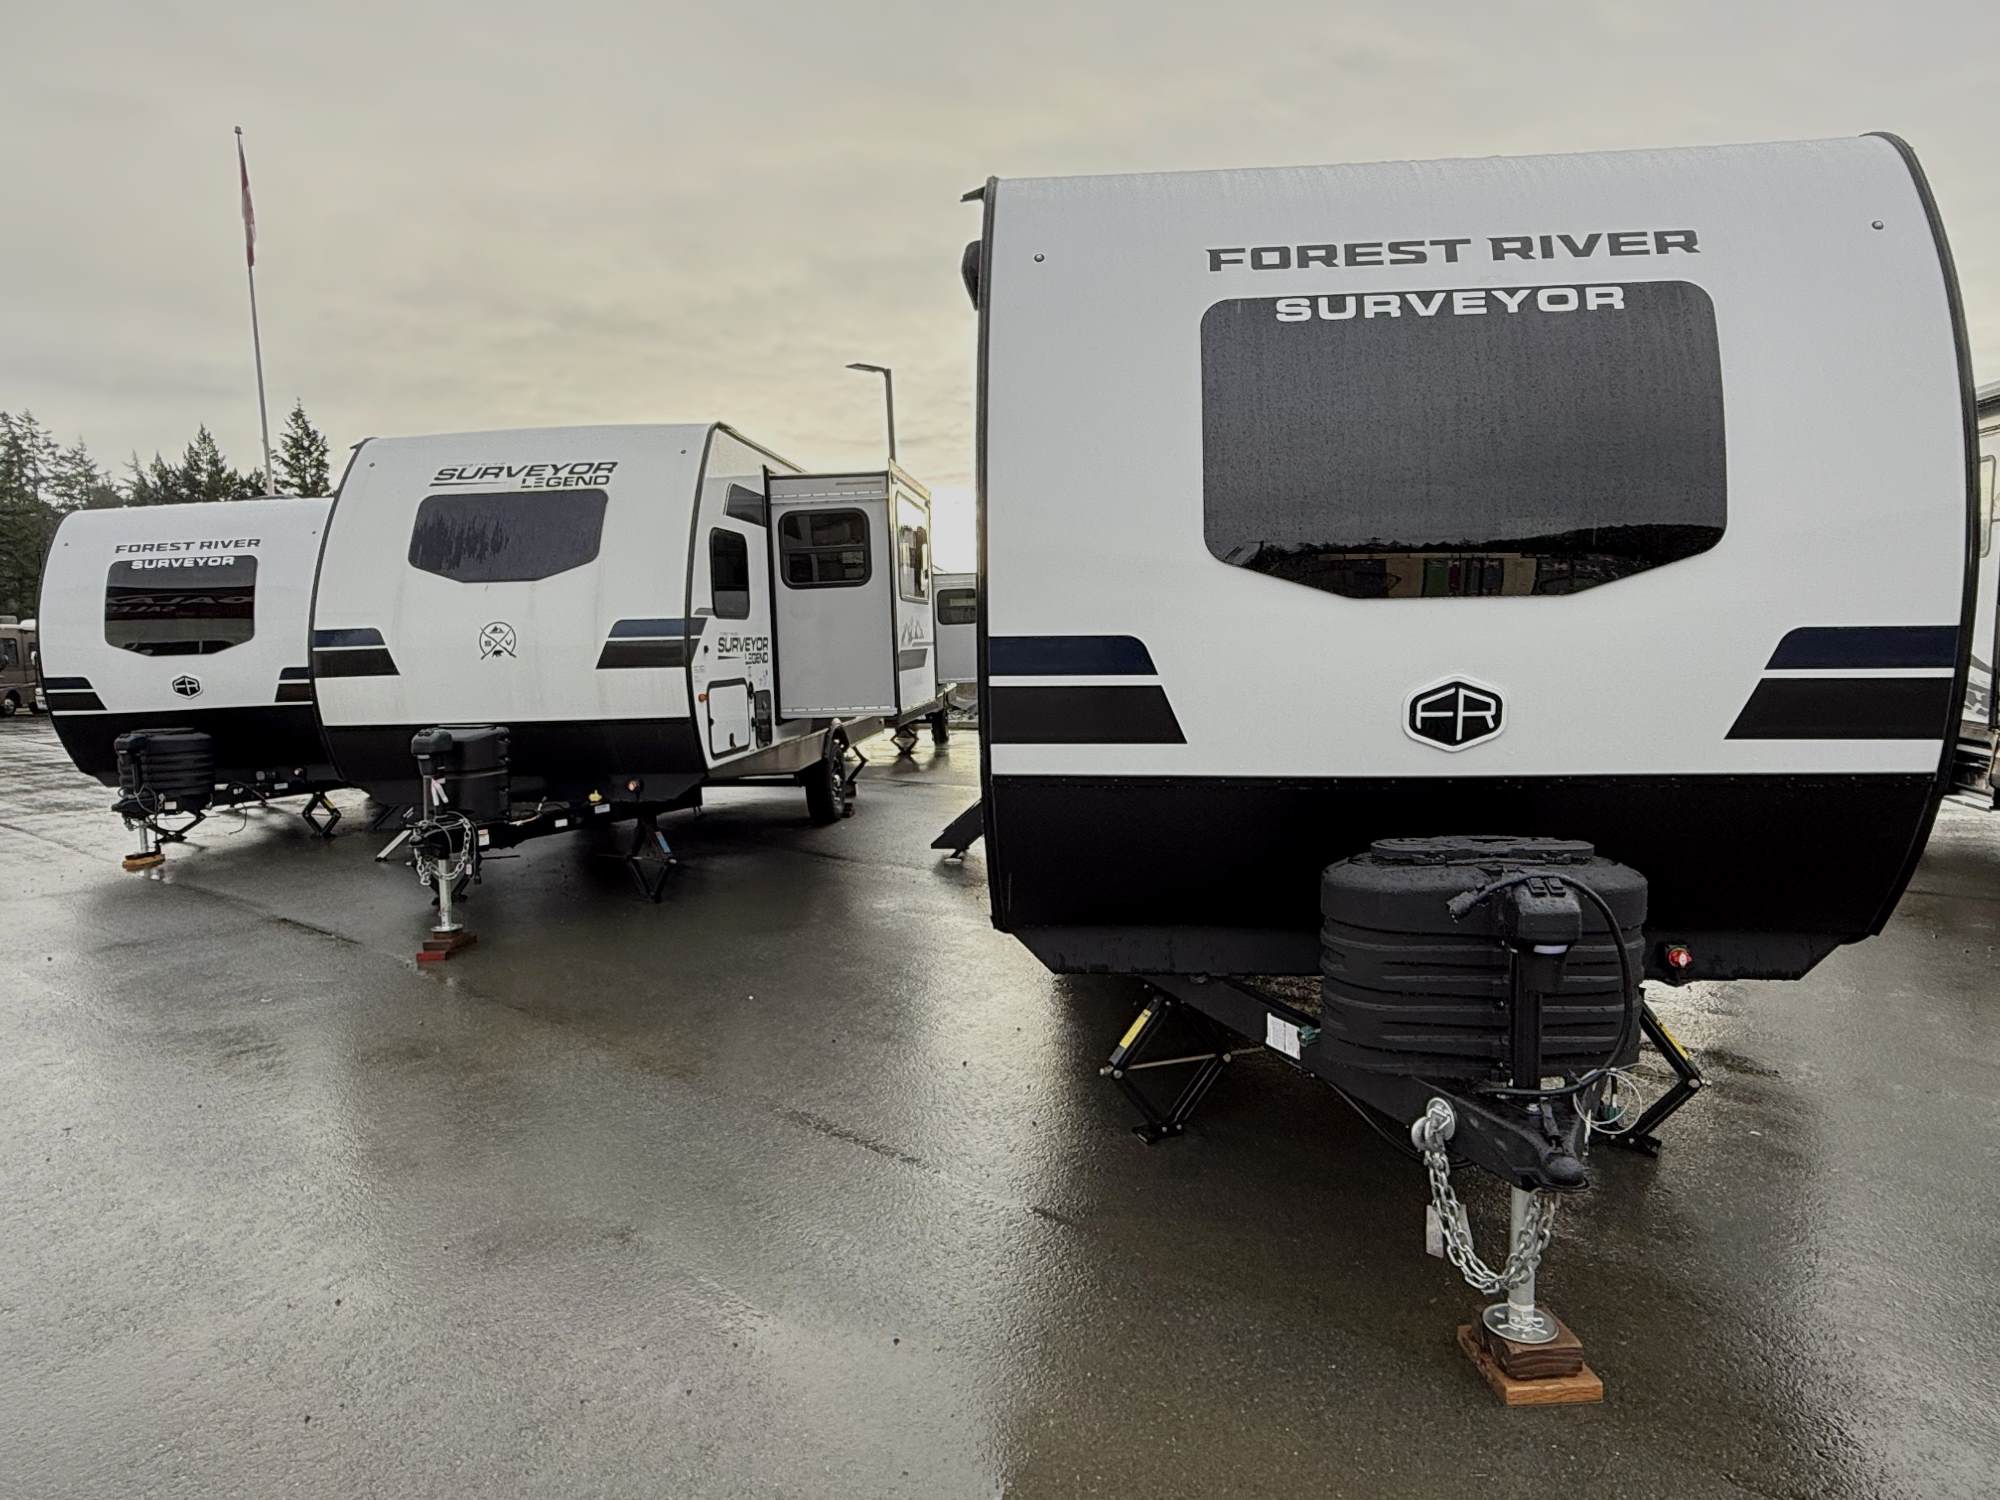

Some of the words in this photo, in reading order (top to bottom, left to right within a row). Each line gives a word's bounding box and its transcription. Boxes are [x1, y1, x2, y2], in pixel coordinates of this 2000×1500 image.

[1205, 238, 1471, 272] FOREST
[1487, 229, 1701, 261] RIVER
[1275, 285, 1625, 322] SURVEYOR
[433, 462, 618, 481] SURVEYOR
[521, 475, 610, 488] LEGEND
[115, 542, 196, 553] FOREST
[200, 539, 261, 550] RIVER
[131, 556, 235, 569] SURVEYOR
[718, 637, 768, 653] SURVEYOR
